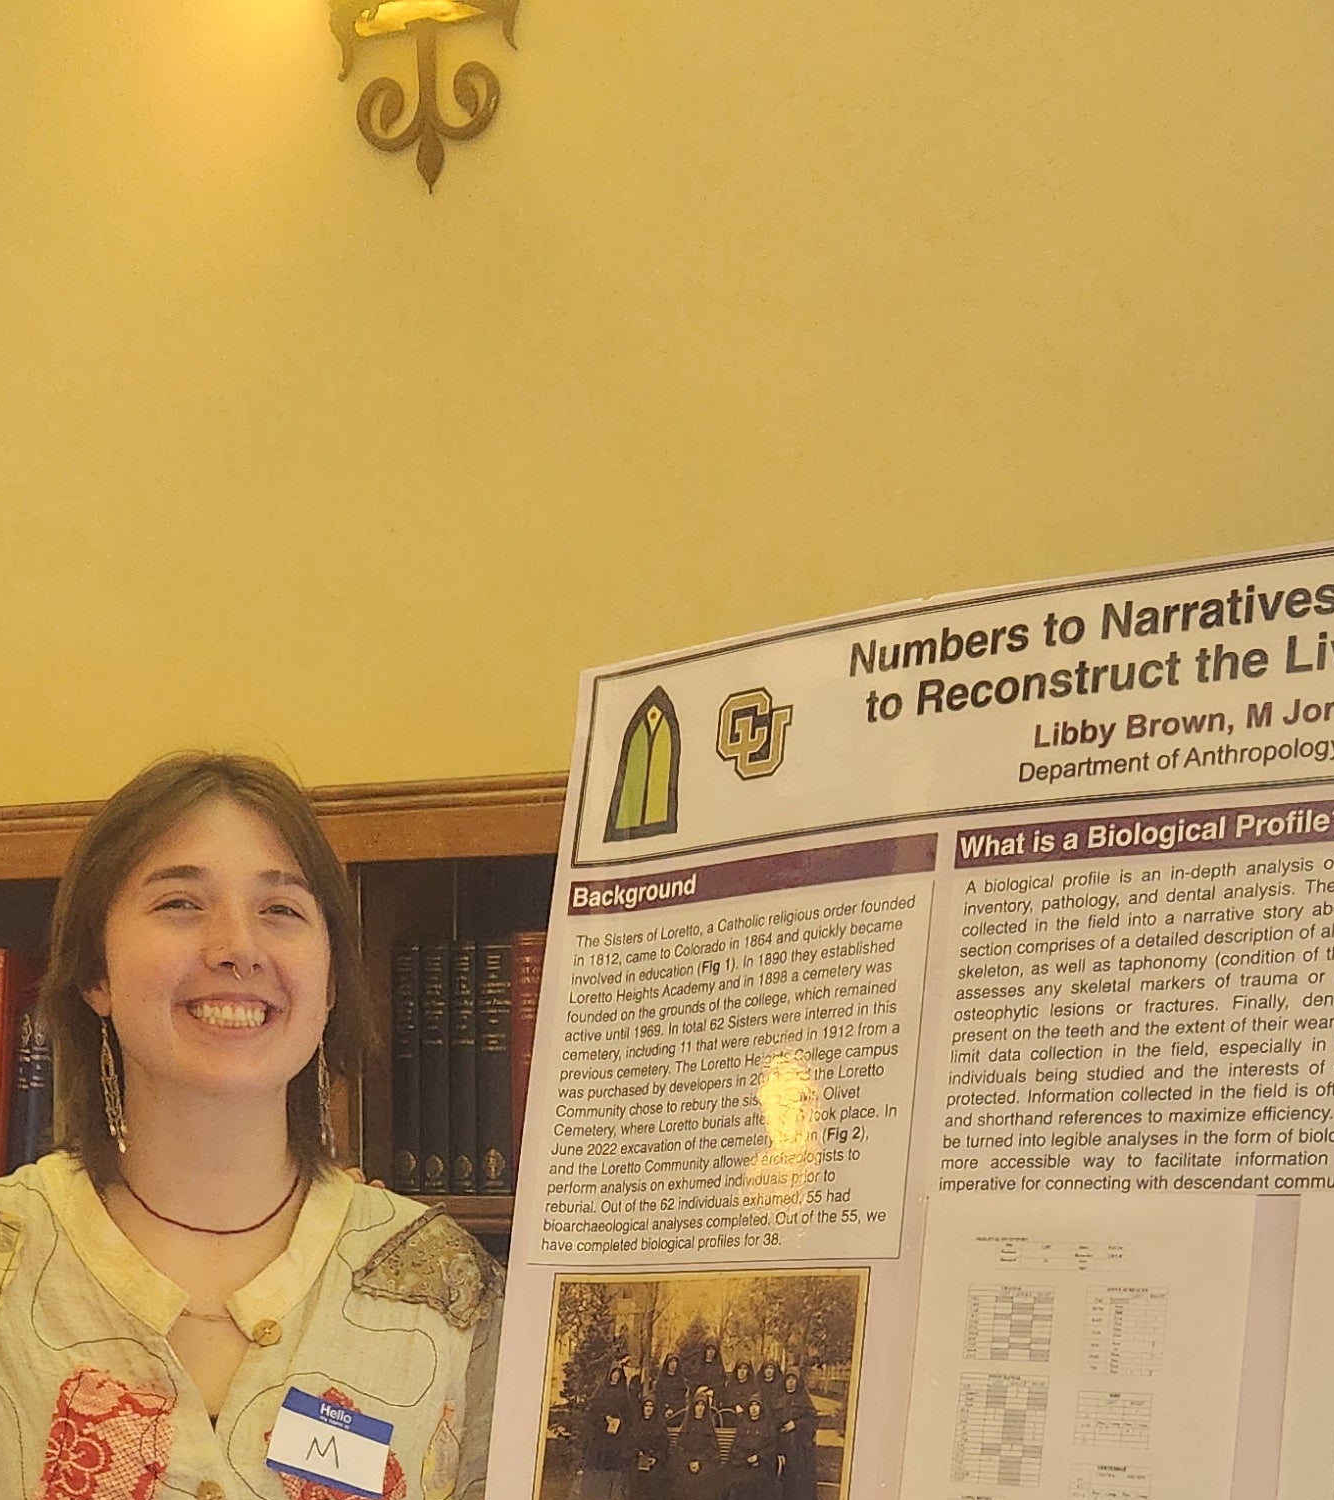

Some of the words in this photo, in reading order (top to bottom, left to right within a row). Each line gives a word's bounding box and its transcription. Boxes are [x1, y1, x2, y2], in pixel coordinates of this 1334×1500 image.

[849, 623, 1029, 677] Numbers
[1044, 612, 1085, 647] to
[866, 689, 903, 723] to
[917, 651, 1181, 716] Reconstruct
[1196, 643, 1268, 684] the
[1033, 719, 1117, 750] Libby
[1126, 710, 1235, 741] Brown,
[1246, 702, 1273, 729] M
[1018, 750, 1150, 784] Department
[1156, 748, 1182, 770] of
[959, 834, 1026, 860] What
[1033, 829, 1055, 854] is
[1062, 833, 1079, 851] a
[1087, 817, 1227, 851] Biological
[572, 873, 697, 909] Background
[576, 934, 600, 949] The
[604, 930, 643, 947] Sisters
[646, 928, 657, 942] of
[660, 921, 704, 942] Loretto,
[707, 923, 714, 934] a
[717, 914, 765, 933] Catholic
[768, 908, 820, 928] religious
[823, 902, 857, 920] order
[860, 896, 916, 915] founded
[938, 1176, 1016, 1194] imperative
[1021, 1175, 1041, 1190] for
[1045, 1174, 1131, 1193] connecting
[1136, 1174, 1168, 1190] with
[1173, 1173, 1269, 1190] descendant
[320, 1403, 352, 1424] Hello
[306, 1435, 340, 1469] M
